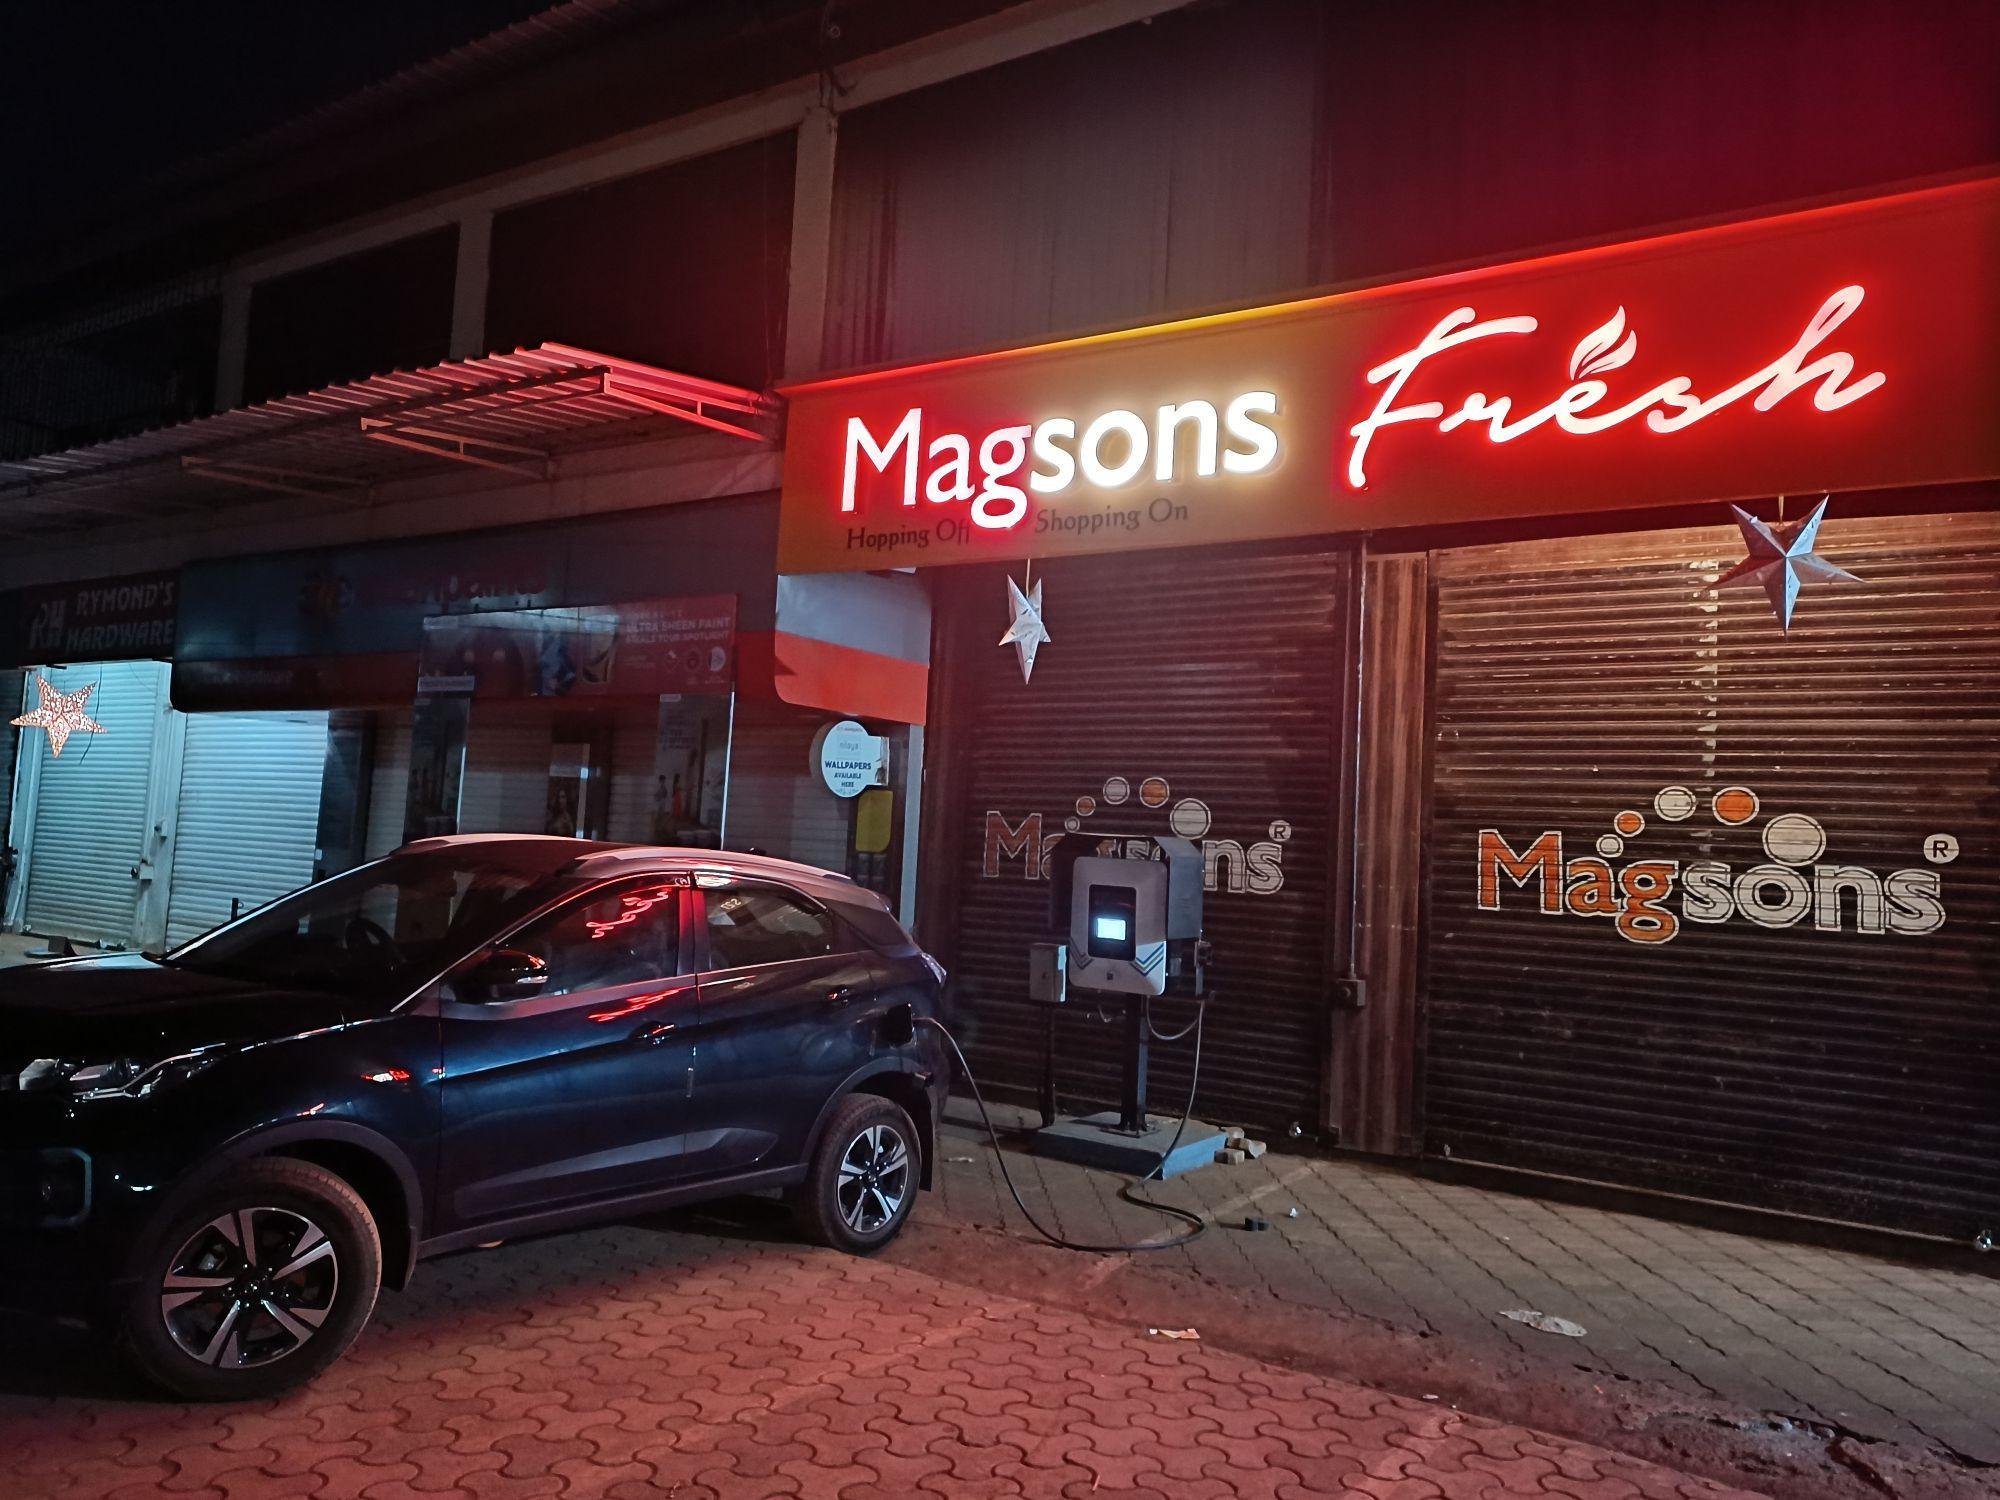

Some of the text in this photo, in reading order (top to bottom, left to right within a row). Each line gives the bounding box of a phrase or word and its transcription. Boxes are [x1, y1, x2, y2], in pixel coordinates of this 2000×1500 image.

[841, 285, 1887, 529] Magsons Fresh
[847, 498, 1188, 552] Hopping Off Shopping On
[76, 580, 175, 616] RYMOND'S
[65, 619, 175, 654] HARDWARE
[699, 617, 731, 629] PAINT
[824, 760, 872, 770] WALLPAPERS
[1477, 829, 1946, 943] Magsons
